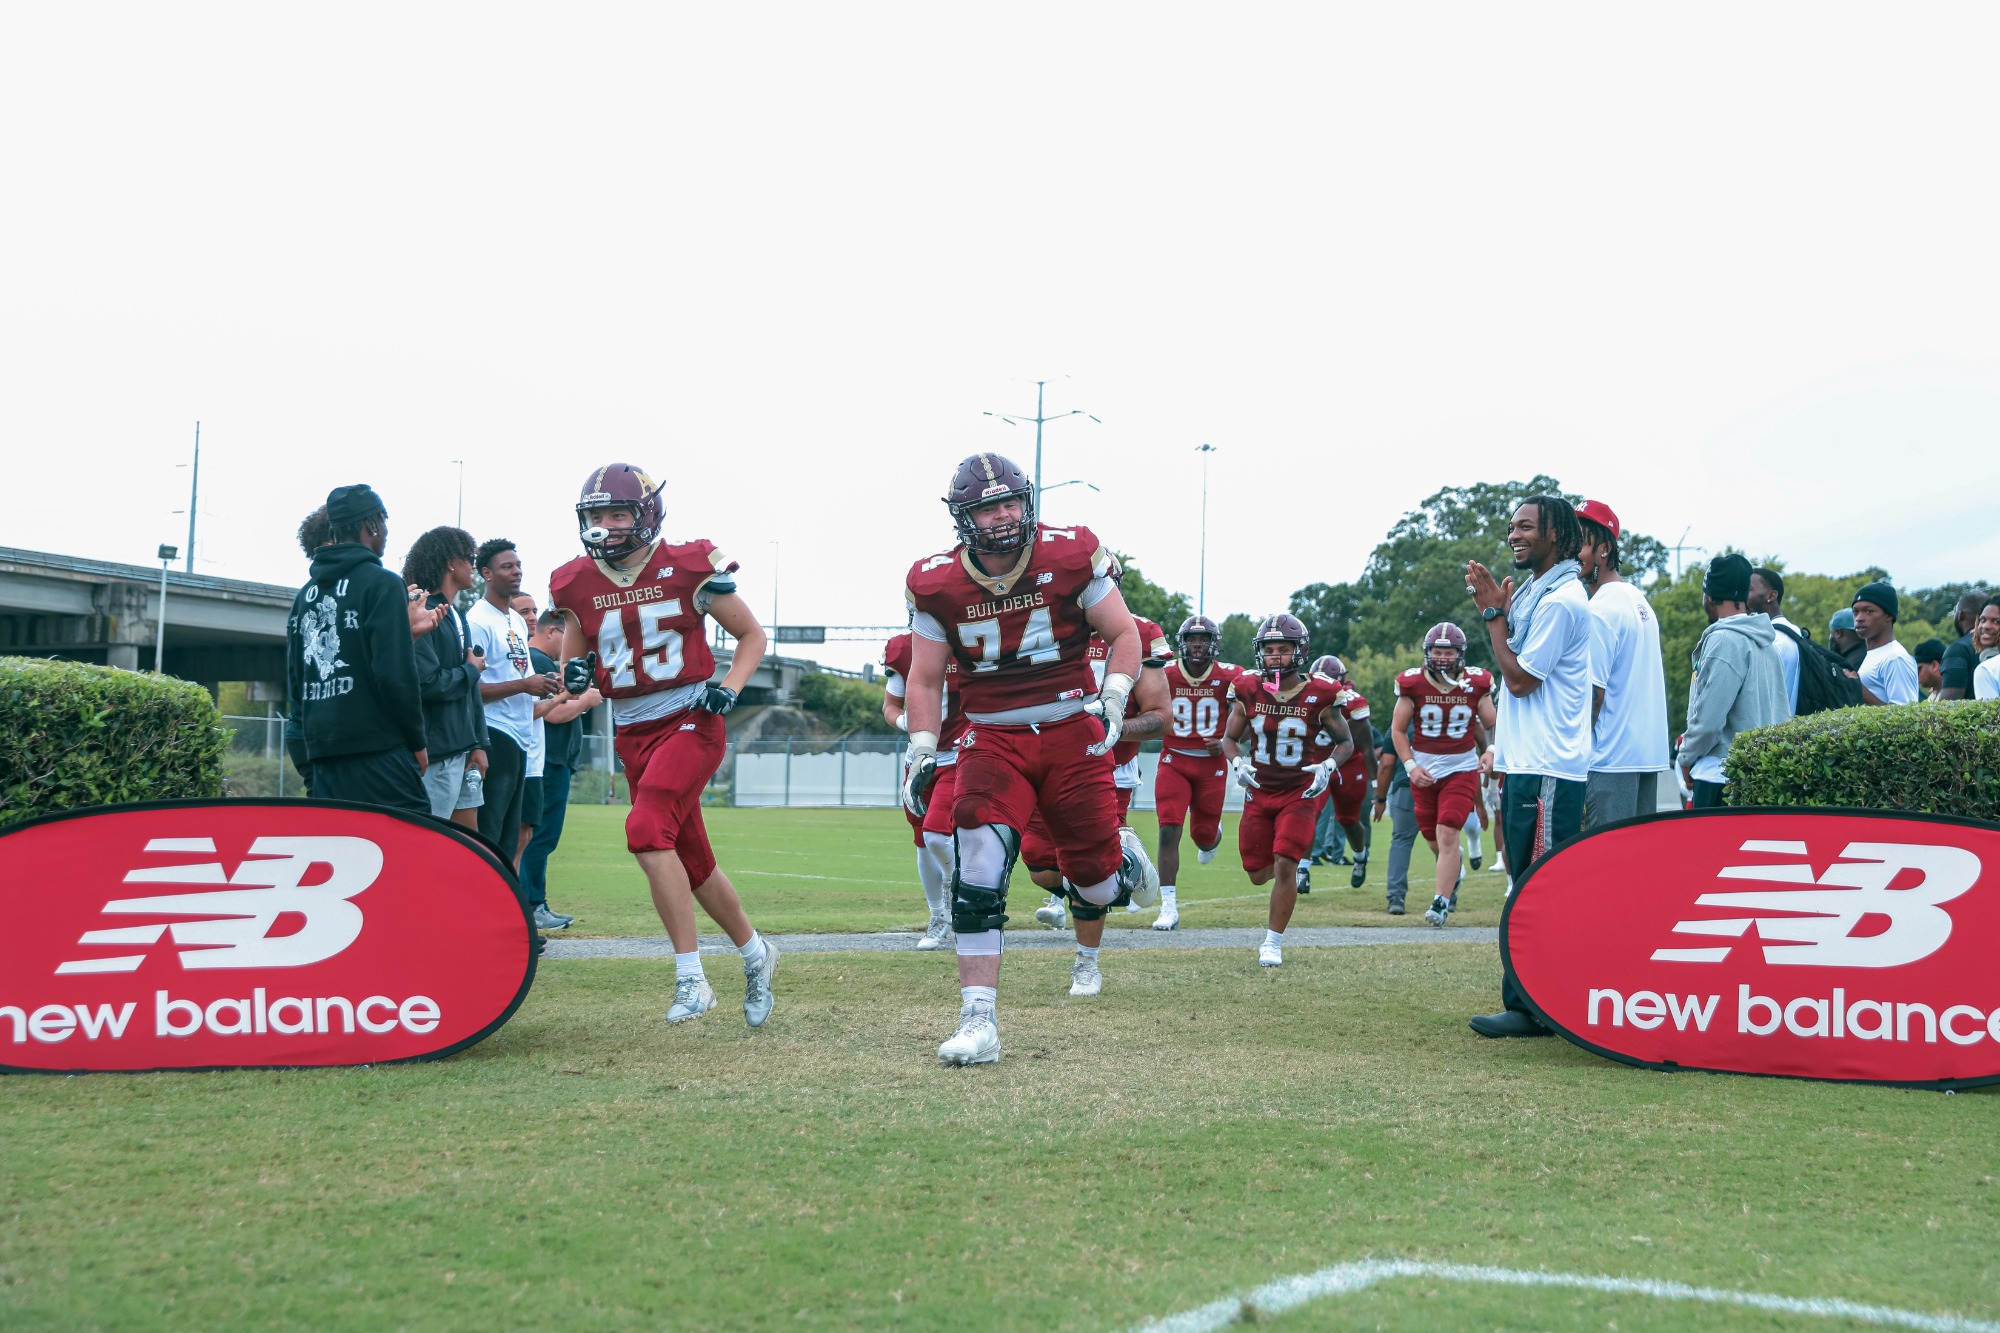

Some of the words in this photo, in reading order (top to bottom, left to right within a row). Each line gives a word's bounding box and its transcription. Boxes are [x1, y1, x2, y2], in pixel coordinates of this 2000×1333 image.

[593, 585, 664, 610] BUILDERS
[966, 592, 1044, 619] BUILDERS
[598, 598, 685, 689] 45
[957, 606, 1061, 673] 74
[1175, 687, 1214, 696] BUILDERS
[1255, 702, 1308, 717] BUILDERS
[1425, 695, 1468, 704] BUILDERS
[1172, 697, 1220, 738] 90
[1420, 704, 1473, 739] 88
[1250, 713, 1308, 767] 16
[54, 836, 384, 975] NB
[1650, 839, 1981, 968] NB
[156, 988, 441, 1037] balance
[1587, 988, 1720, 1033] new
